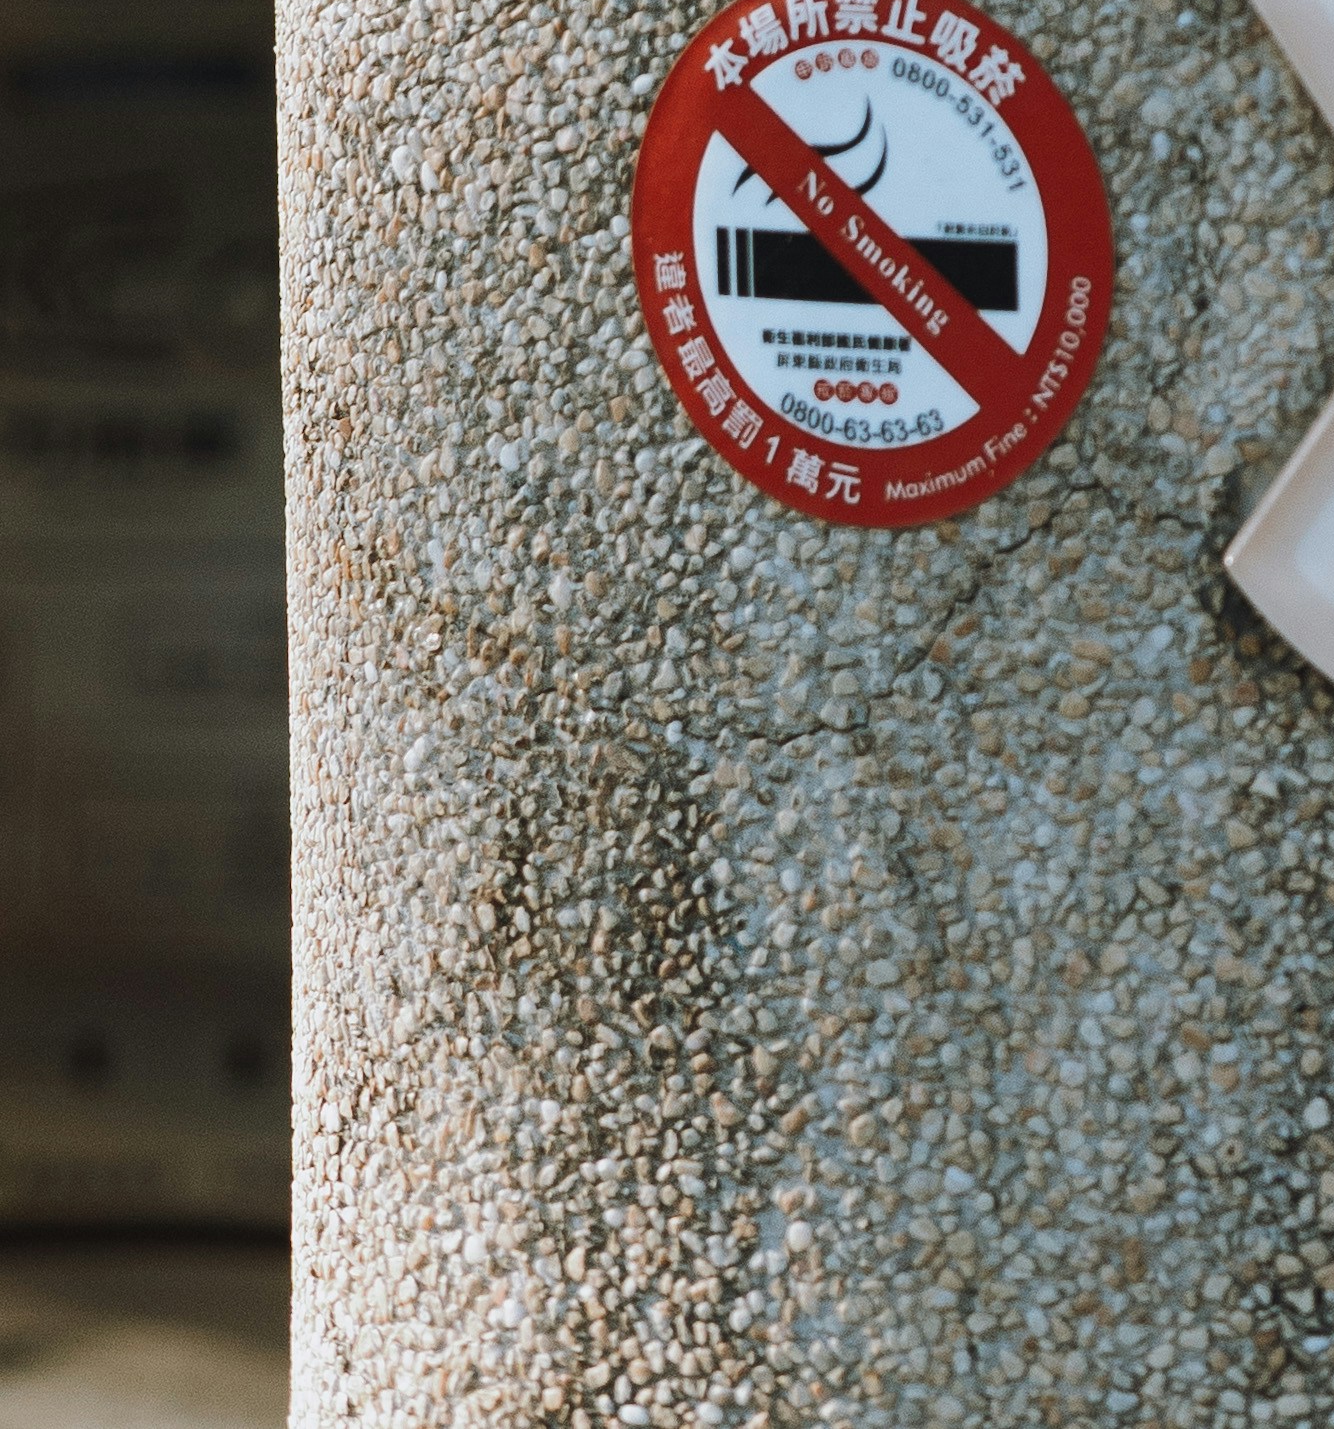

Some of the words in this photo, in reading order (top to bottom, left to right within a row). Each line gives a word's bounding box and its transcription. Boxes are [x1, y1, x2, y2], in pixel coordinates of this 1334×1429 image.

[891, 56, 1027, 193] 0800-531-531
[797, 168, 835, 216] No
[840, 214, 950, 337] Smoking
[780, 392, 945, 444] 0800-63-63-63
[884, 455, 987, 501] Maximum
